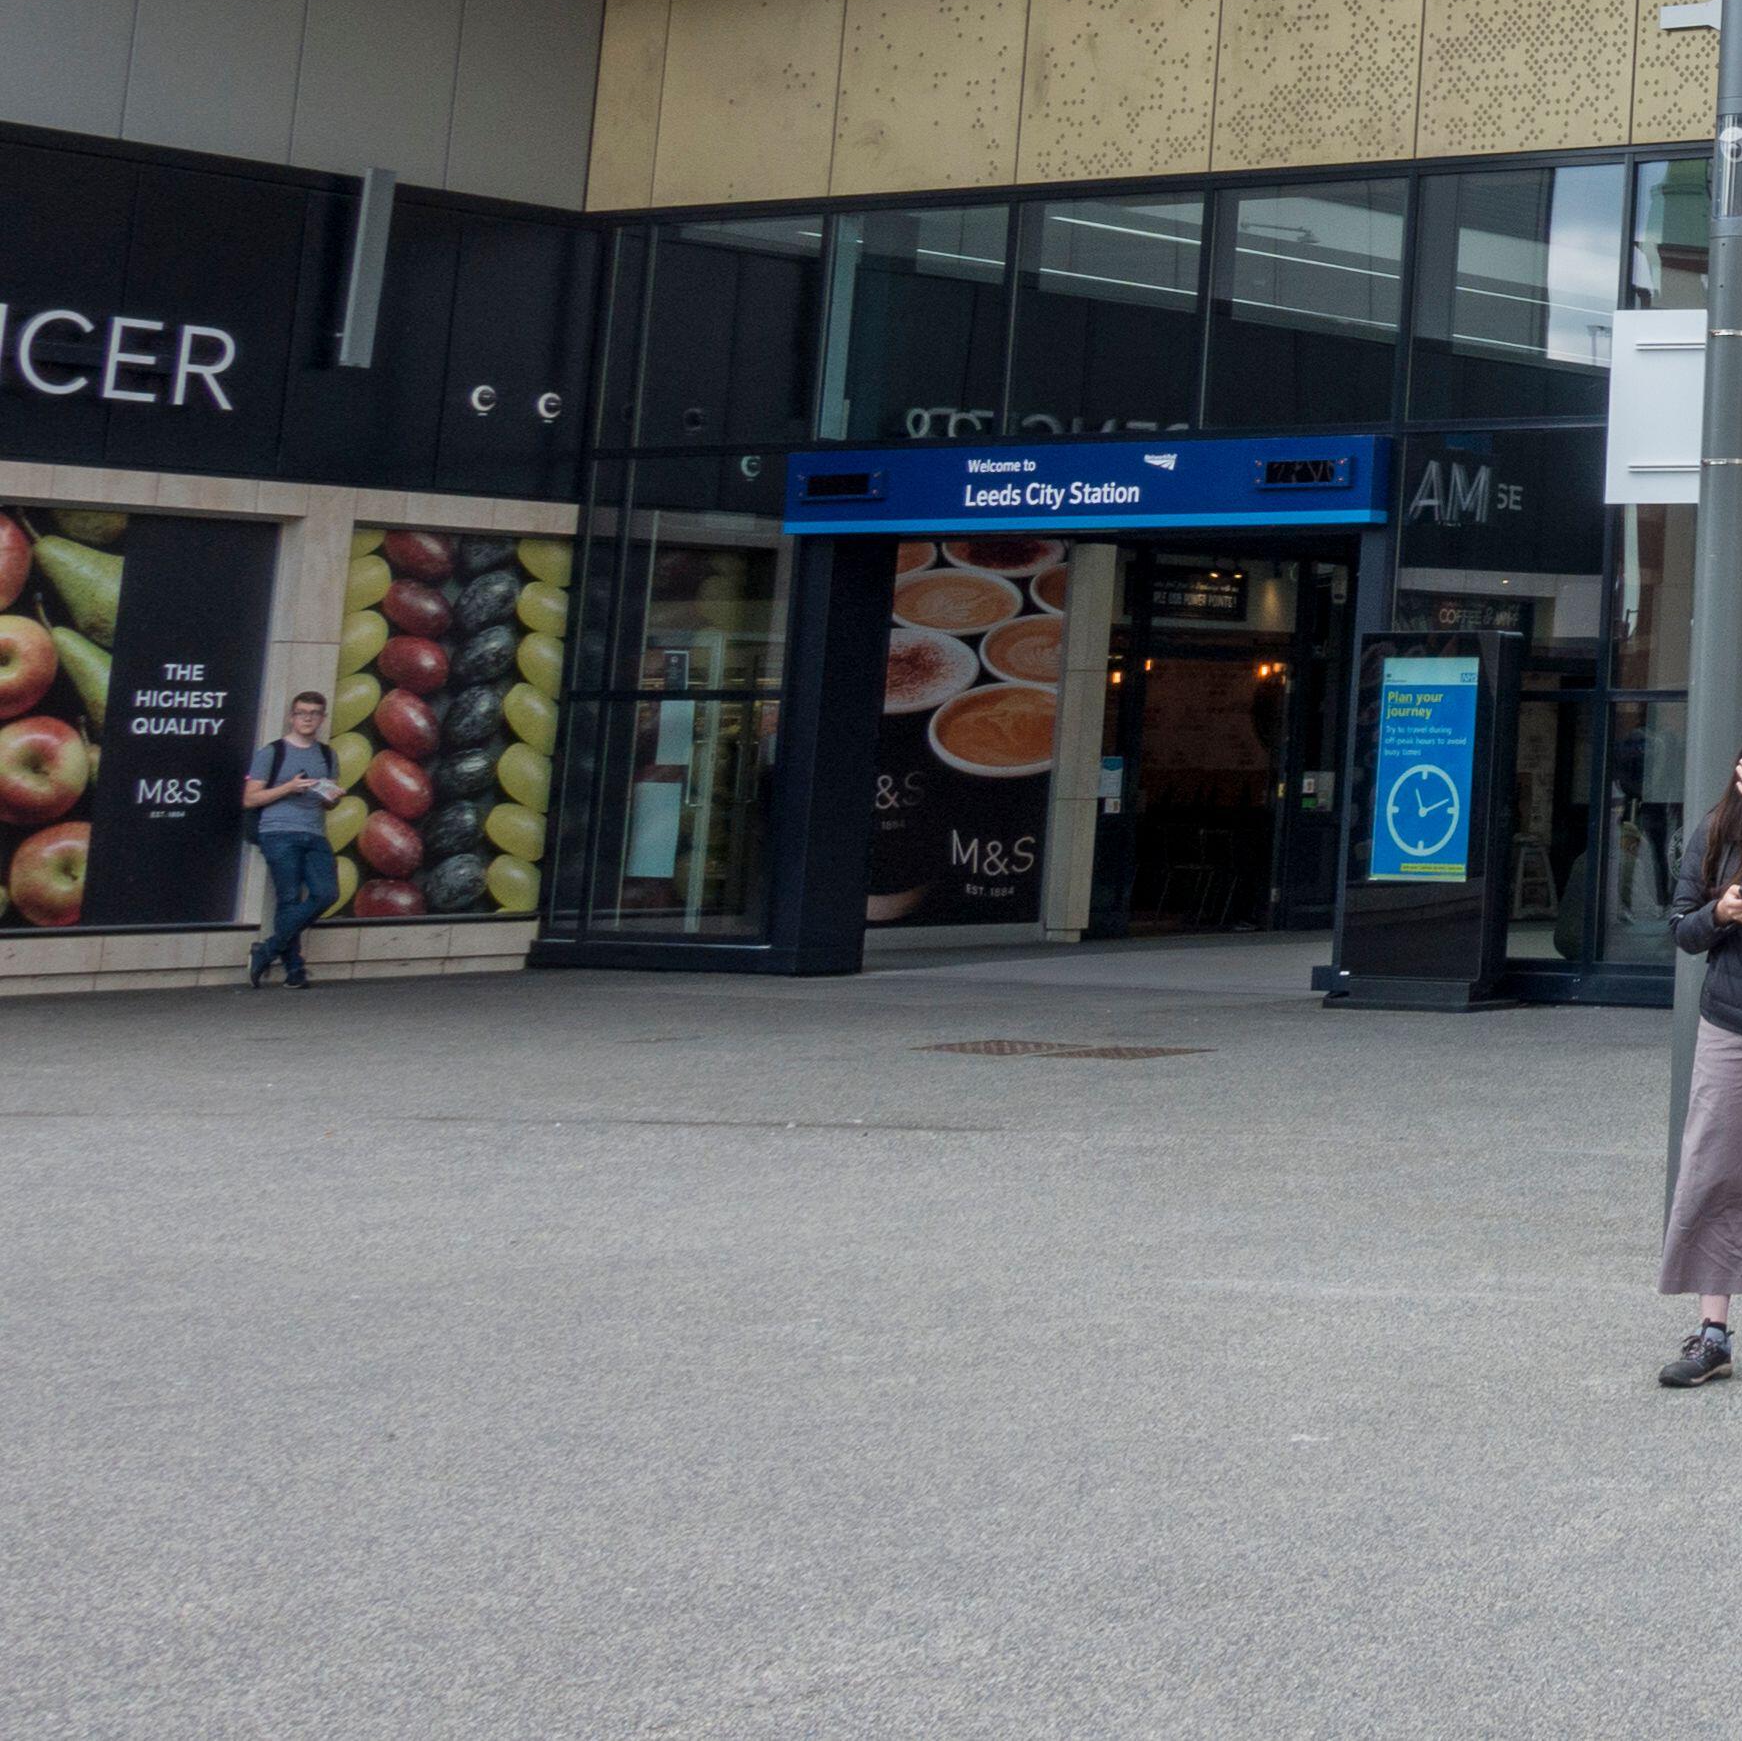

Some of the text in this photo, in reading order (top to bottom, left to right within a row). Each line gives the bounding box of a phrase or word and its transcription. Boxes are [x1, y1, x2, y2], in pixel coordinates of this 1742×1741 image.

[0, 304, 236, 410] CER
[967, 459, 1037, 473] Welcome to
[964, 481, 1141, 511] Leeds City Station
[164, 663, 205, 682] THE
[134, 689, 228, 709] HIGHEST
[1386, 691, 1444, 706] Plan your
[1385, 705, 1433, 720] journey
[131, 717, 225, 736] QUALITY
[136, 778, 203, 804] M&S
[875, 770, 924, 809] &S
[952, 829, 1036, 877] M&S
